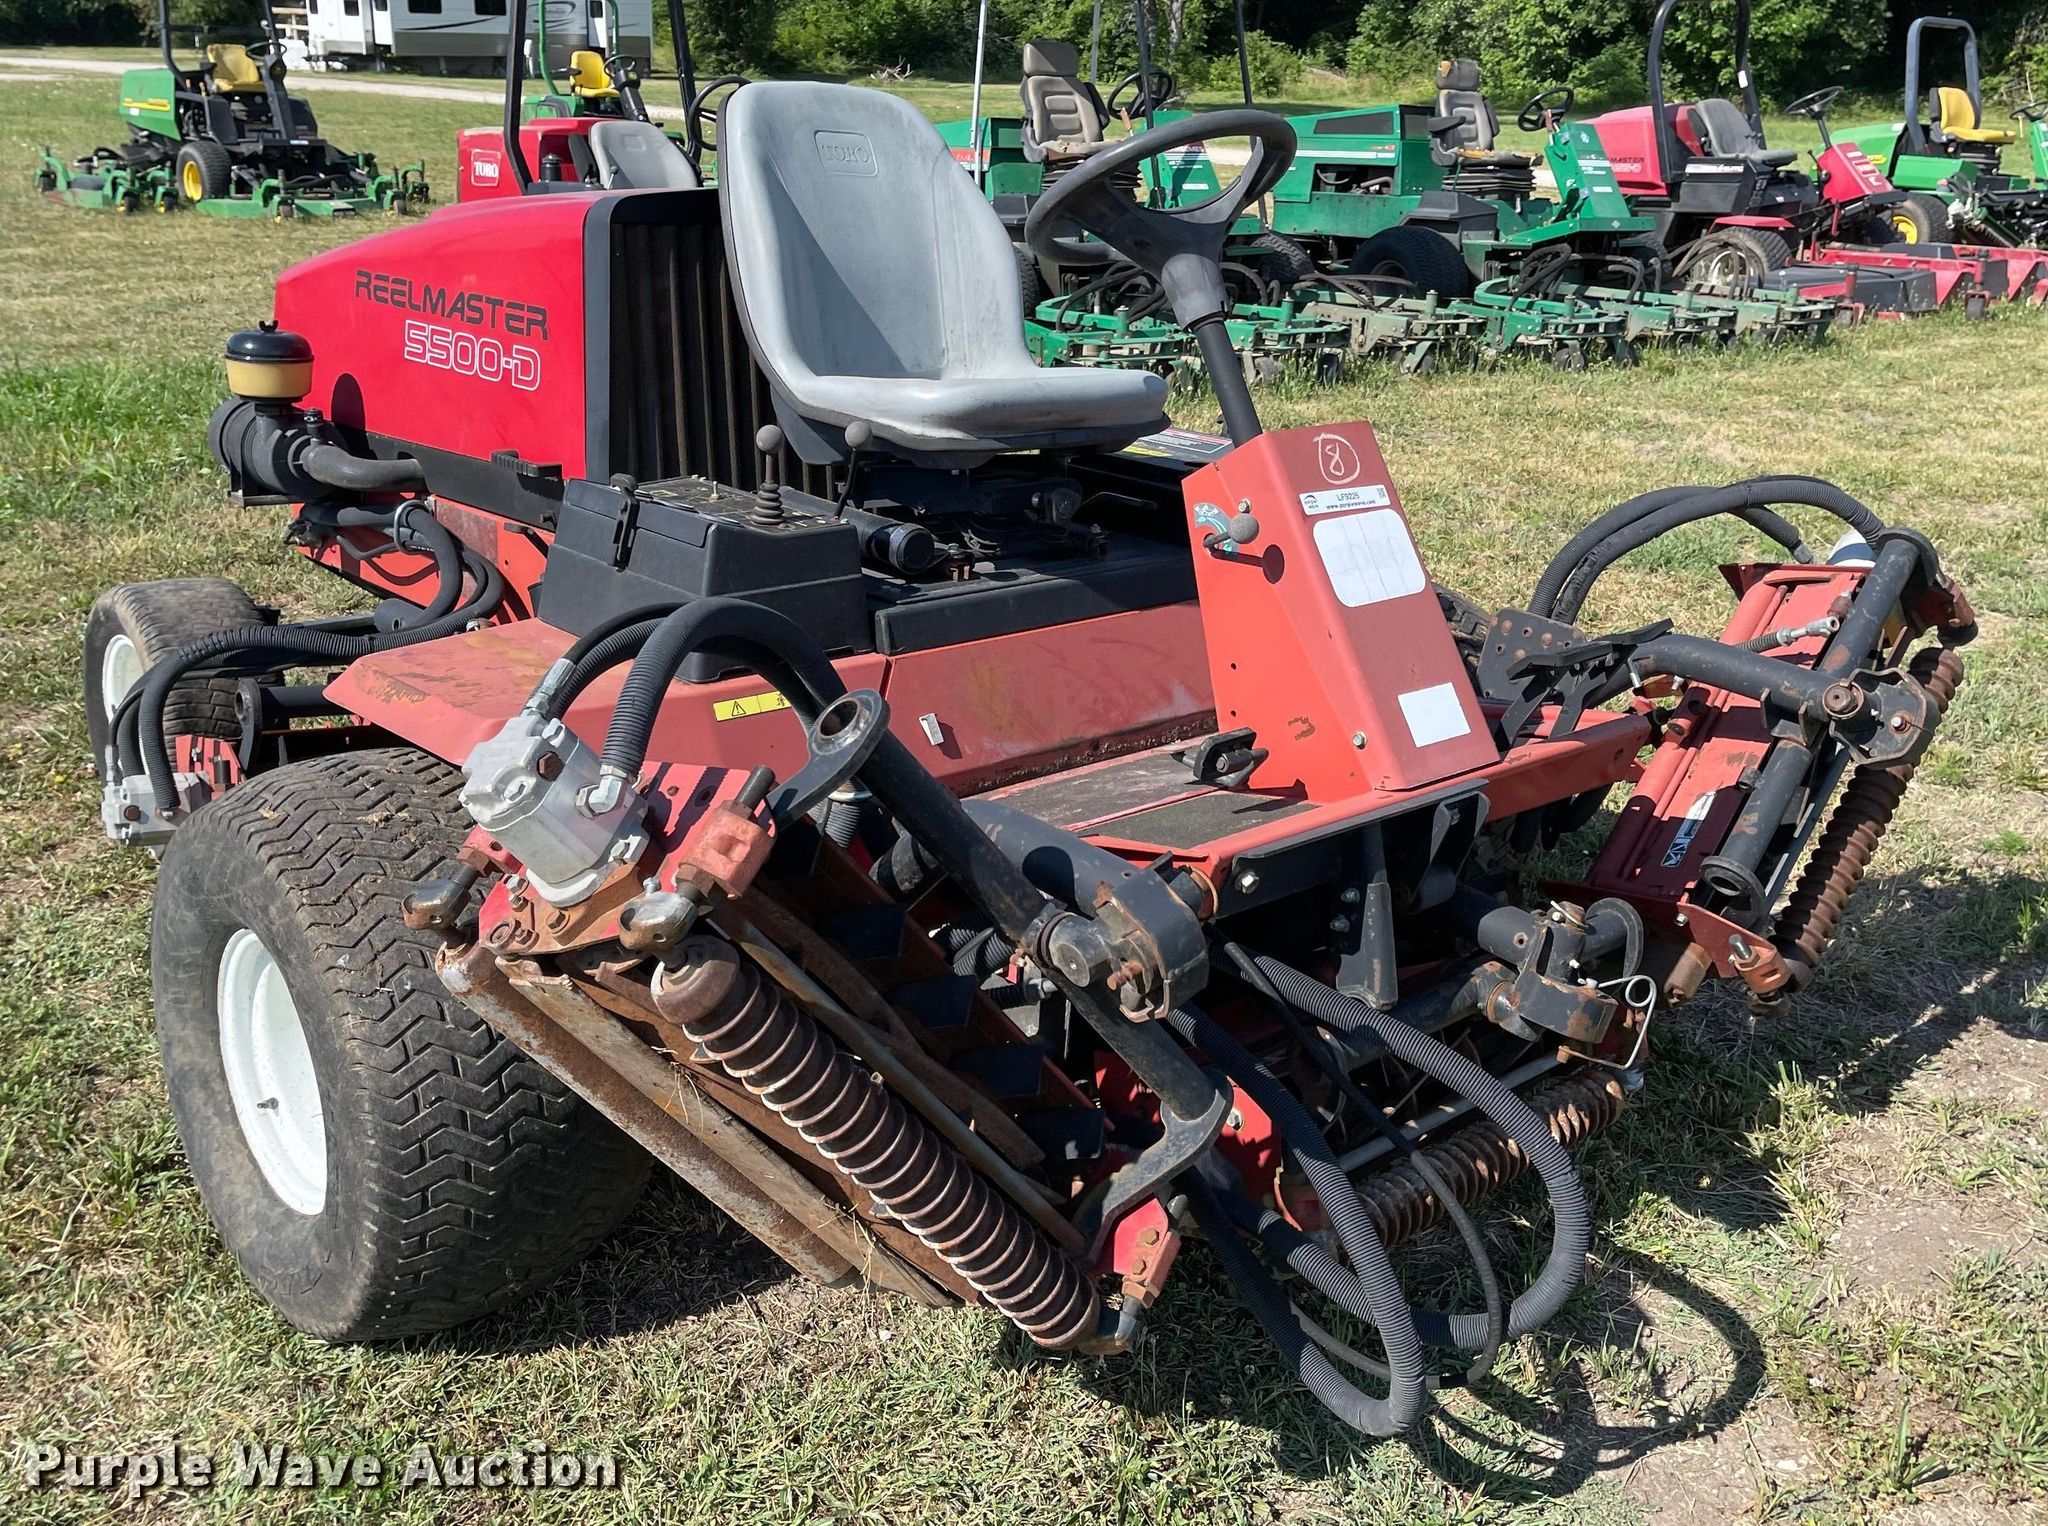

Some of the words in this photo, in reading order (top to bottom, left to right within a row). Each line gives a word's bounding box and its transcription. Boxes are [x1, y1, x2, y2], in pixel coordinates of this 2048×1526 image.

[474, 161, 499, 178] TORO
[356, 269, 549, 341] REELMASTER
[404, 319, 542, 392] 5500-D
